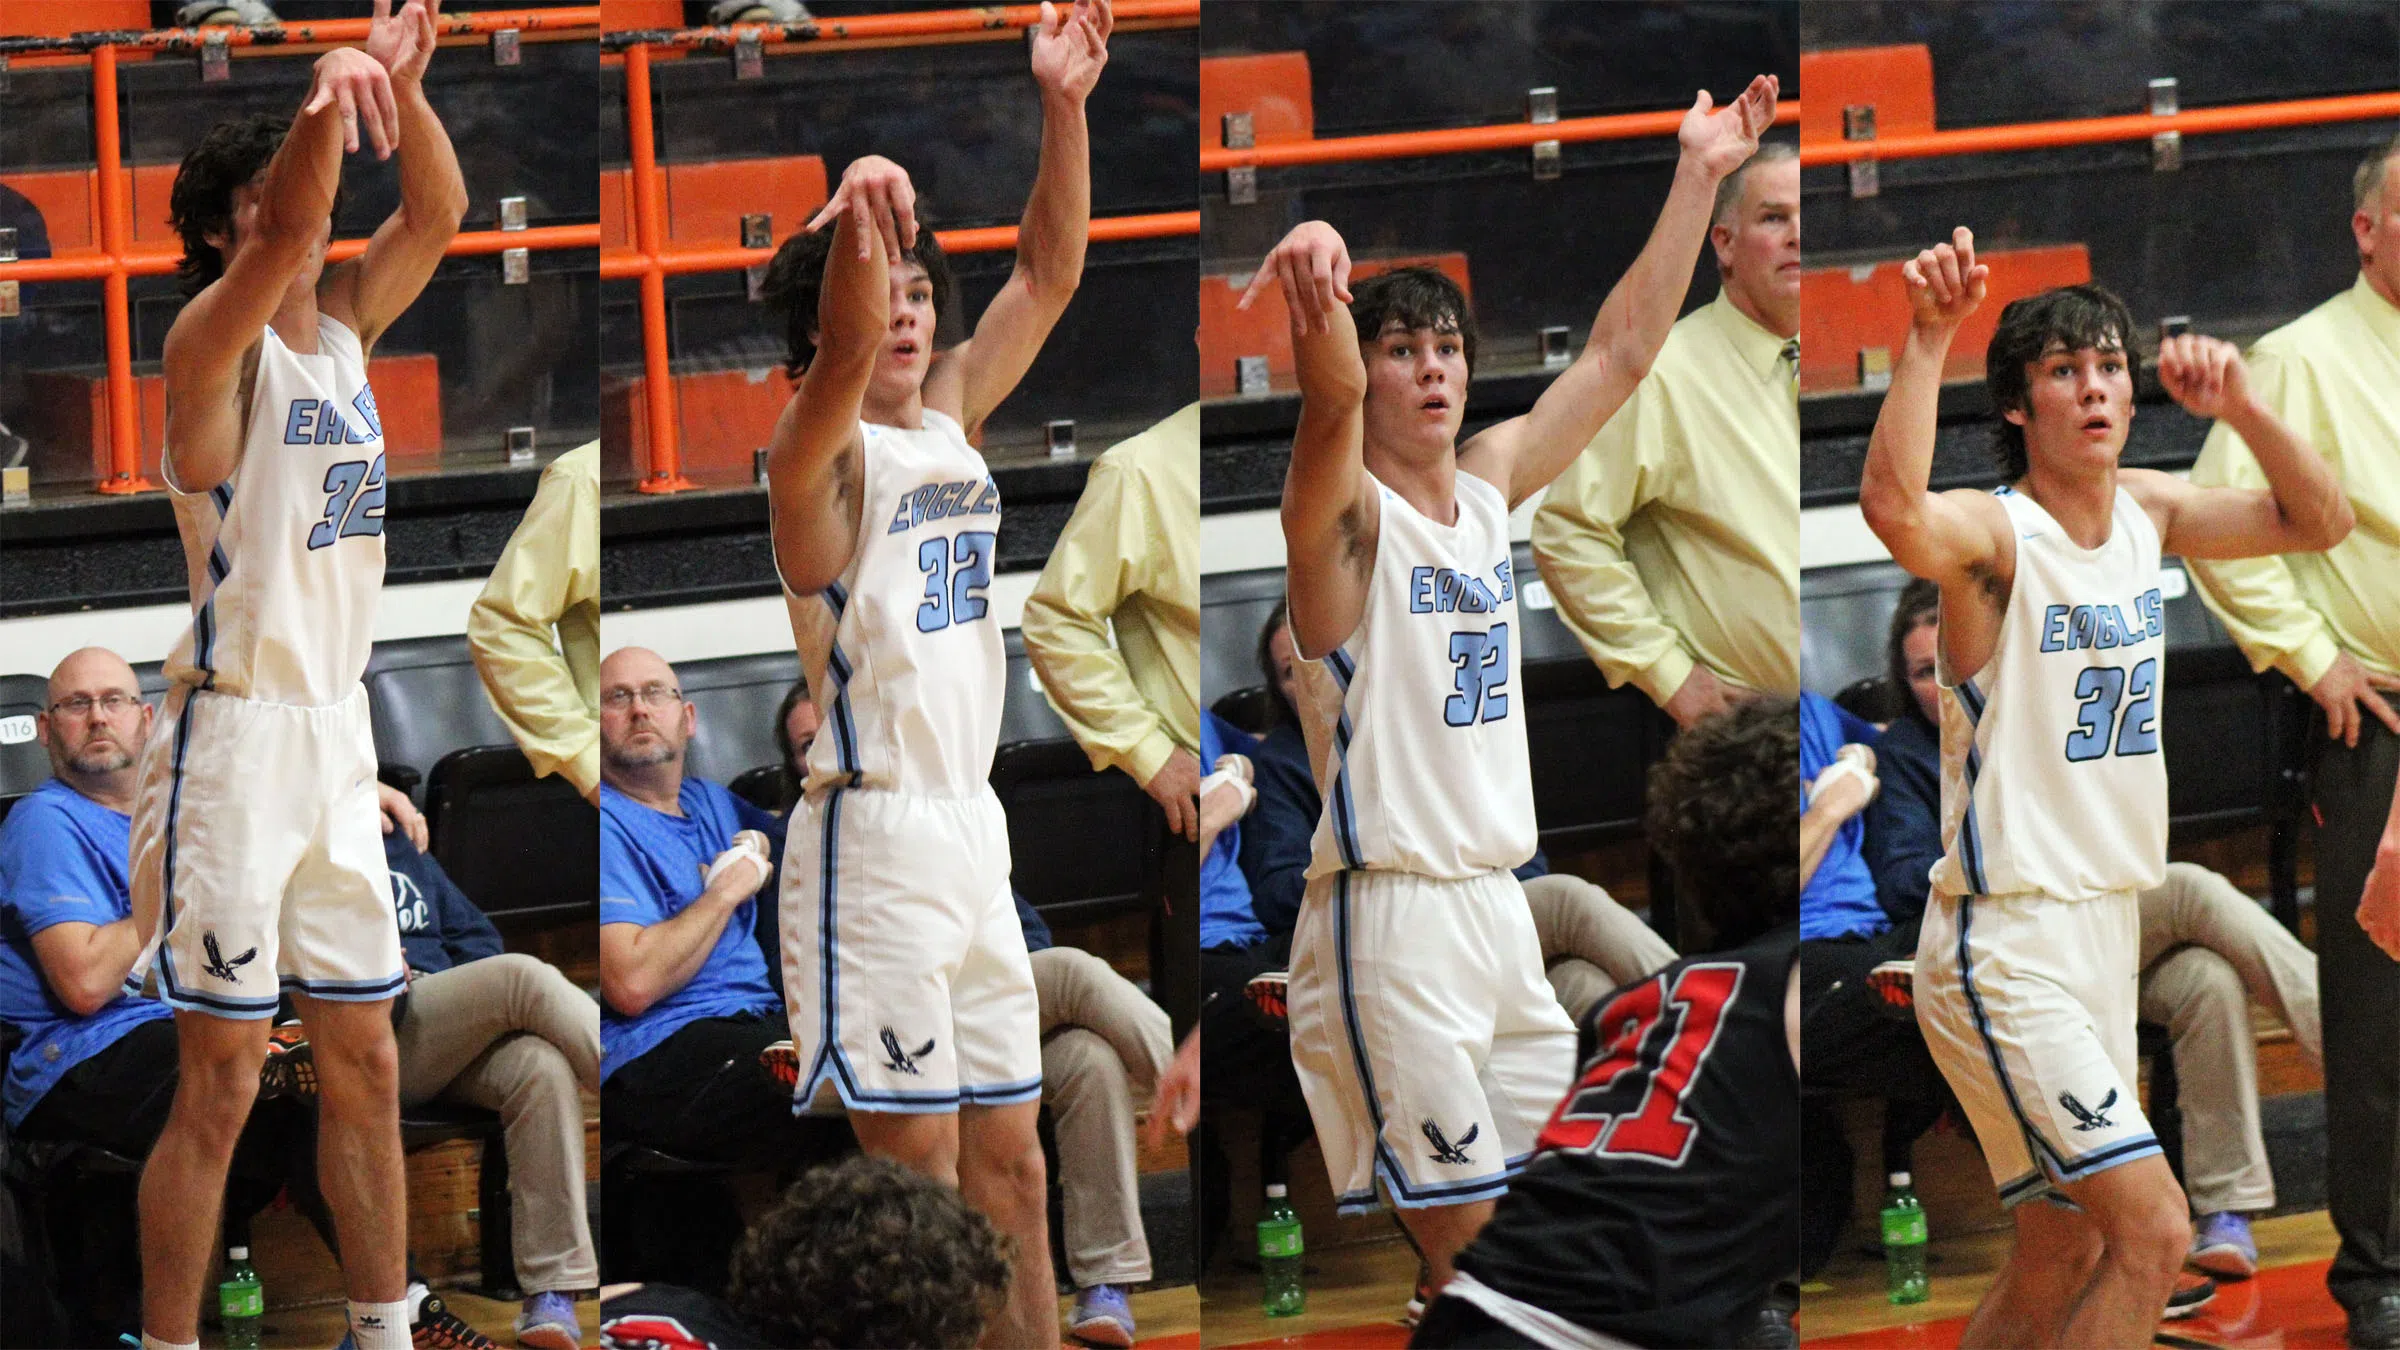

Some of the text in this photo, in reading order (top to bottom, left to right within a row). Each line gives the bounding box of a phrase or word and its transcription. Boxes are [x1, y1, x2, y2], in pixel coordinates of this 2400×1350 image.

[307, 451, 386, 550] 32
[888, 474, 1001, 535] EAGLE
[917, 531, 996, 633] 32
[1444, 621, 1508, 727] 32
[2065, 657, 2157, 762] 32
[3, 720, 32, 738] 116
[1536, 961, 1745, 1168] 21
